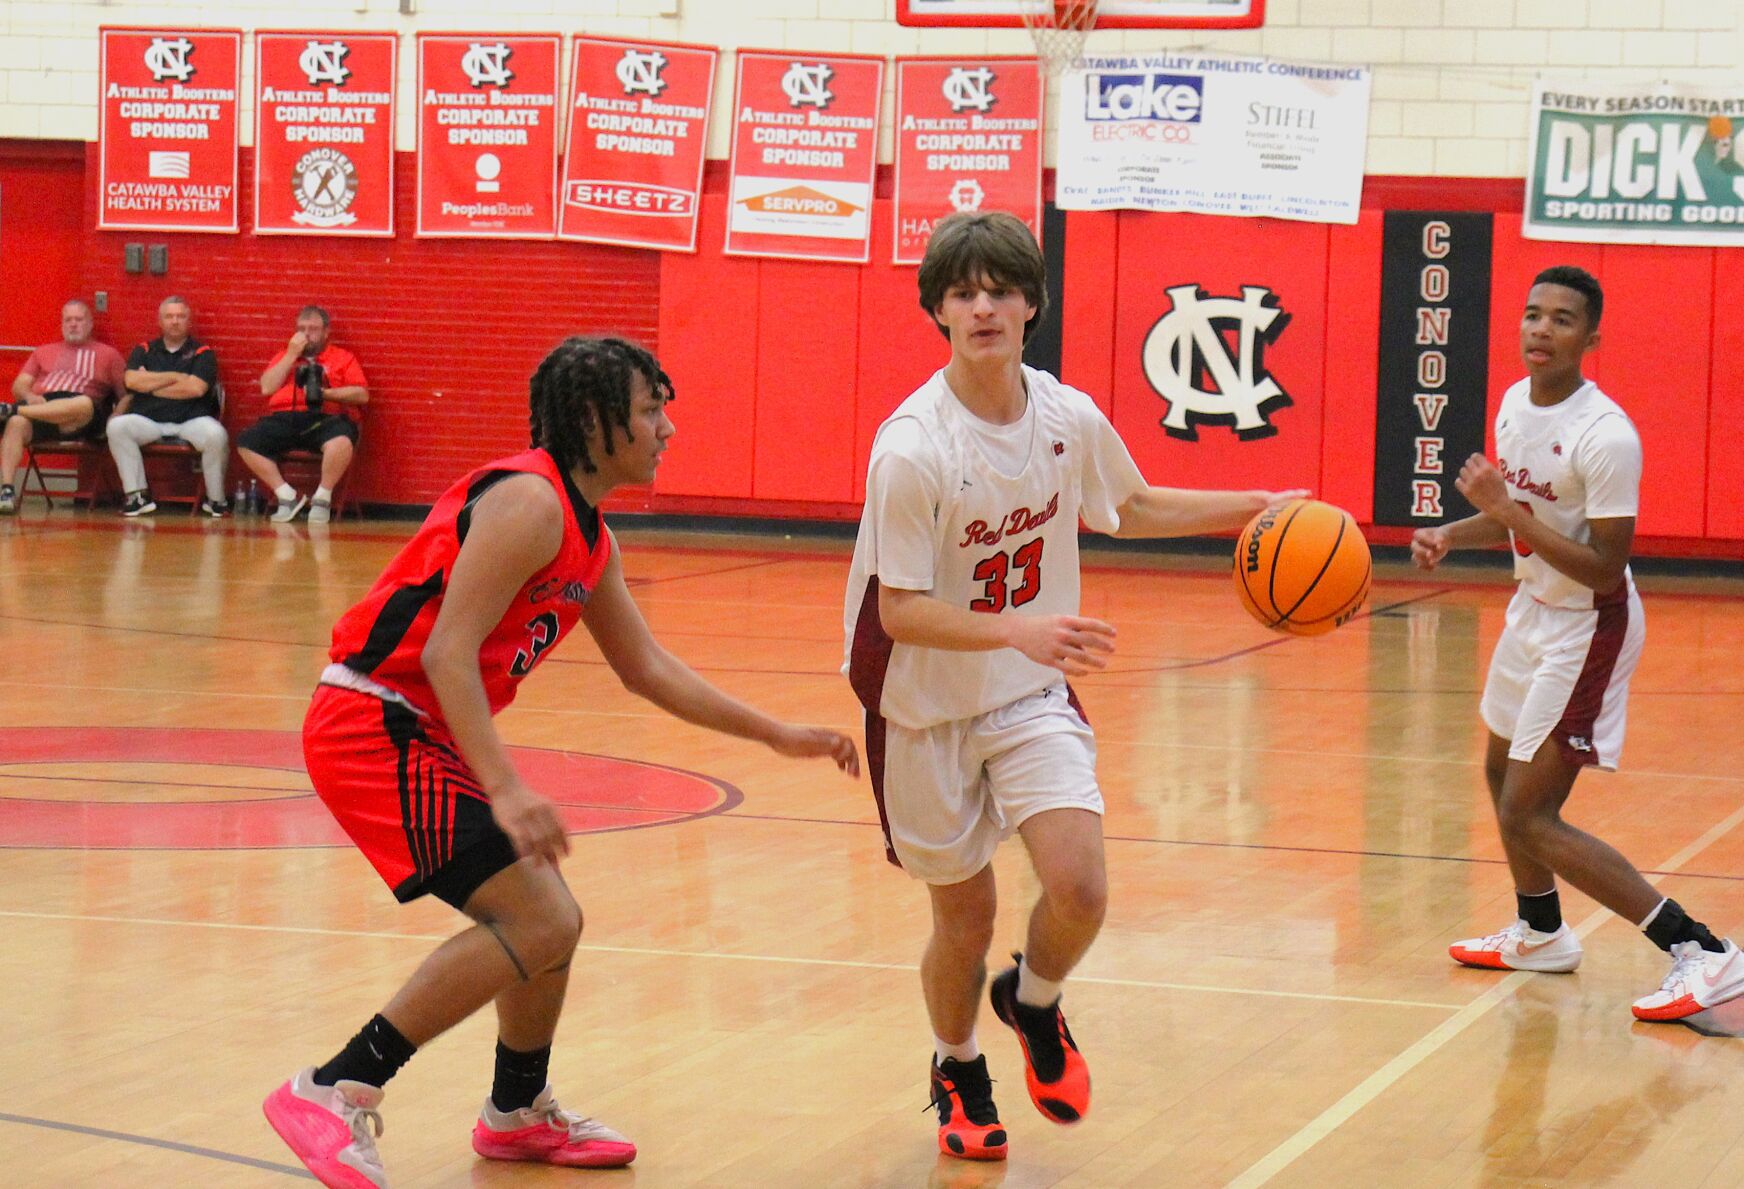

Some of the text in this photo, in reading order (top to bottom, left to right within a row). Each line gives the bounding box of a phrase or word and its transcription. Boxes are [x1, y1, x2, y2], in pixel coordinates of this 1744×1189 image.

[1143, 57, 1194, 70] VALLEY
[1197, 59, 1262, 74] ATHLETIC
[1267, 63, 1362, 82] CONFERENCE
[1086, 75, 1201, 122] Lake
[1541, 91, 1599, 109] EVERY
[1606, 95, 1684, 112] SEASON
[120, 102, 220, 120] CORPORATE
[275, 105, 376, 124] CORPORATE
[438, 109, 539, 126] CORPORATE
[131, 122, 209, 139] SPONSOR
[285, 126, 365, 143] SPONSOR
[587, 112, 688, 138] CORPORATE
[1092, 124, 1155, 142] ELECTRIC
[448, 129, 527, 145] SPONSOR
[596, 134, 674, 156] SPONSOR
[753, 127, 857, 148] CORPORATE
[916, 134, 1022, 151] CORPORATE
[296, 147, 354, 175] CONOVER
[762, 148, 844, 168] SPONSOR
[927, 154, 1010, 171] SPONSOR
[107, 182, 232, 199] CATAWBA VALLEY
[576, 185, 685, 212] SHEETZ
[107, 198, 220, 212] HEALTH SYSTEM
[763, 196, 838, 214] SERVPRO
[1545, 201, 1672, 221] SPORTING
[1411, 221, 1451, 517] CONOVER
[959, 514, 1008, 548] Red
[970, 536, 1044, 614] 33
[508, 610, 560, 678] 3
